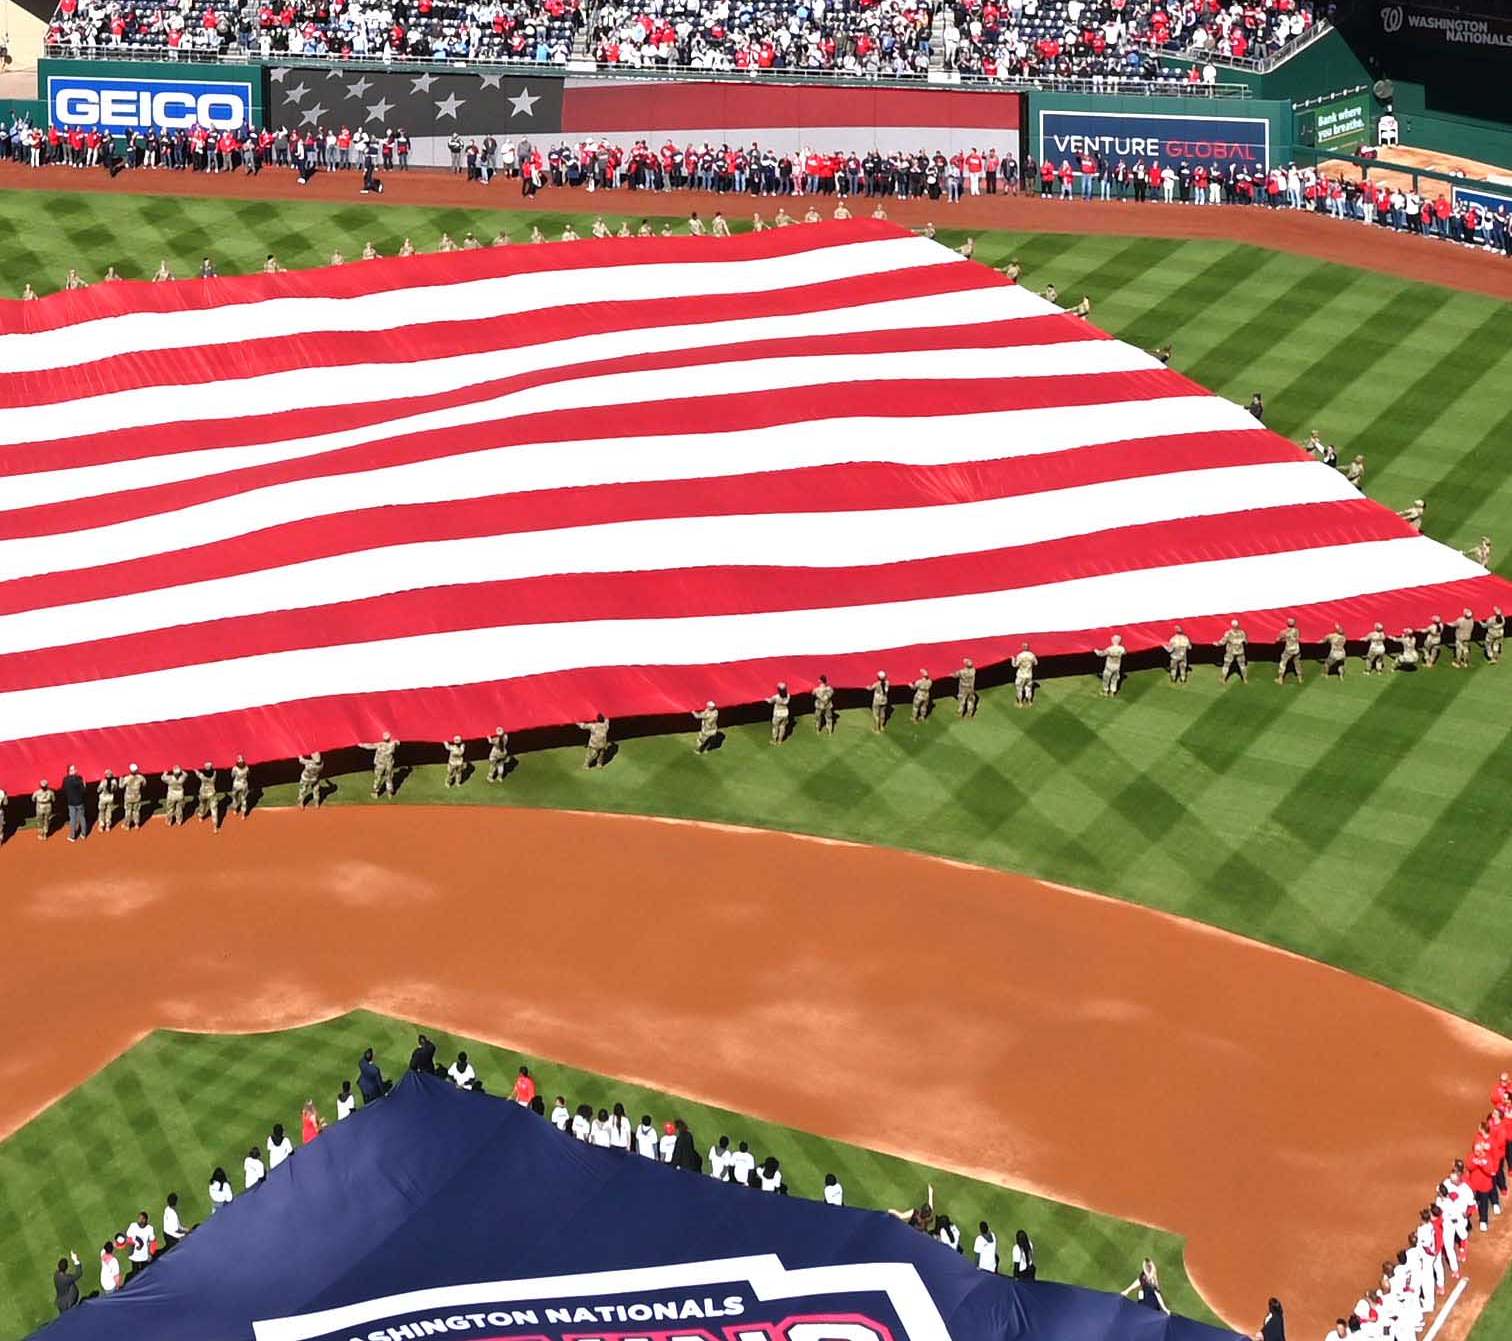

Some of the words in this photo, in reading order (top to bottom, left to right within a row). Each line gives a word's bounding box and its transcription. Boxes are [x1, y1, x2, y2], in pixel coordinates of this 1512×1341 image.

[1407, 14, 1488, 34] WASHINGTON
[55, 90, 244, 129] GEICO
[1052, 133, 1160, 157] VENTURE
[1164, 139, 1257, 161] GLOBAL
[544, 1294, 746, 1325] NATIONALS
